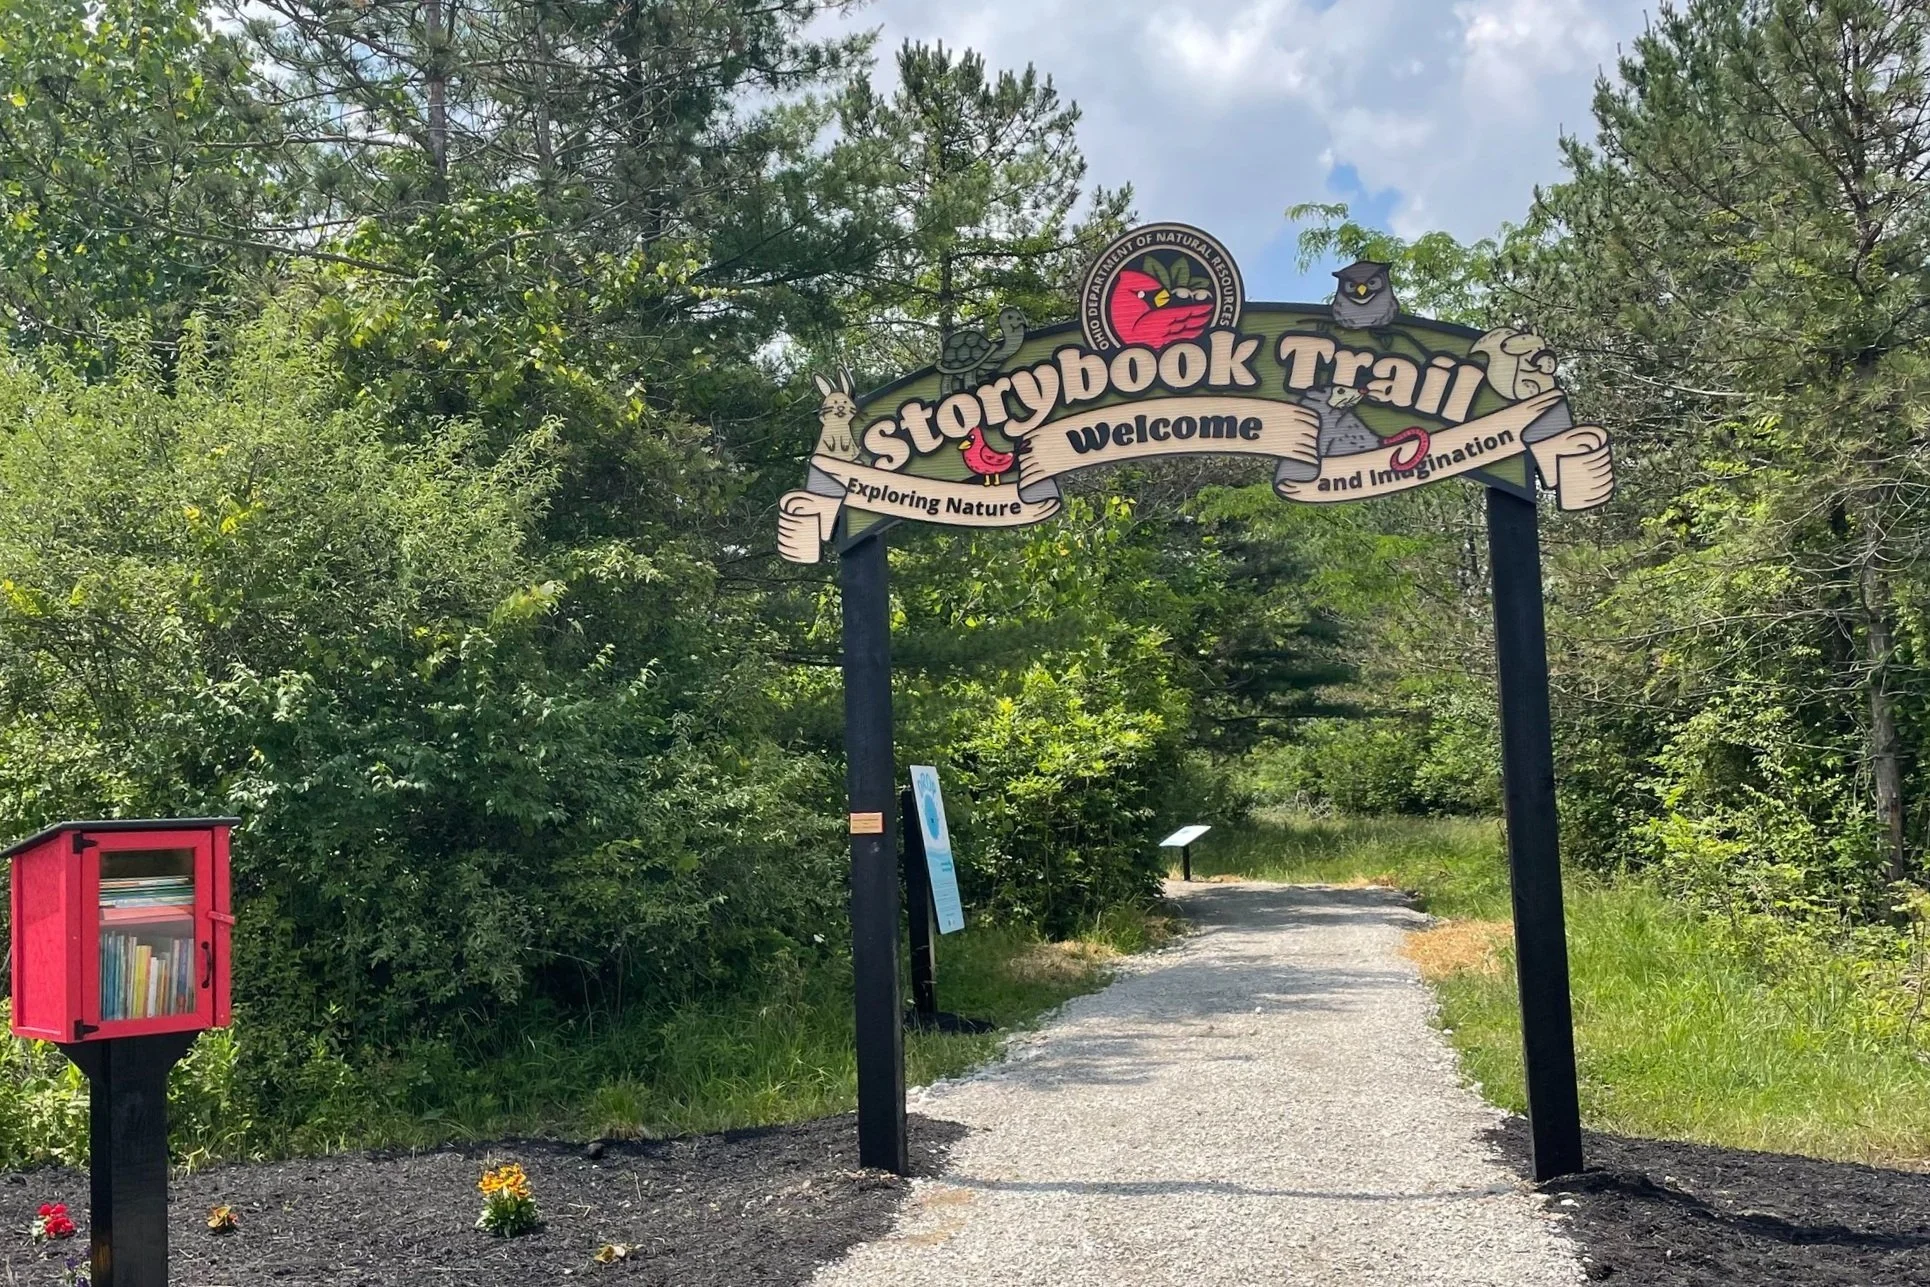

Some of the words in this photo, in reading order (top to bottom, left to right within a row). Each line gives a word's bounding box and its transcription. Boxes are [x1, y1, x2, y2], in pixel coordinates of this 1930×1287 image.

[1136, 233, 1152, 247] OF
[1156, 232, 1210, 259] NATURAL
[1089, 243, 1134, 316] DEPARTMENT
[1211, 254, 1235, 327] RESOURCES
[1089, 320, 1109, 350] OHIO
[863, 330, 1259, 471] Storybook
[1279, 335, 1485, 423] Trail
[1065, 414, 1263, 454] Welcome
[1317, 471, 1362, 491] and
[1369, 429, 1514, 486] Imagination
[847, 478, 941, 514] Exploring
[946, 497, 1022, 517] Nature
